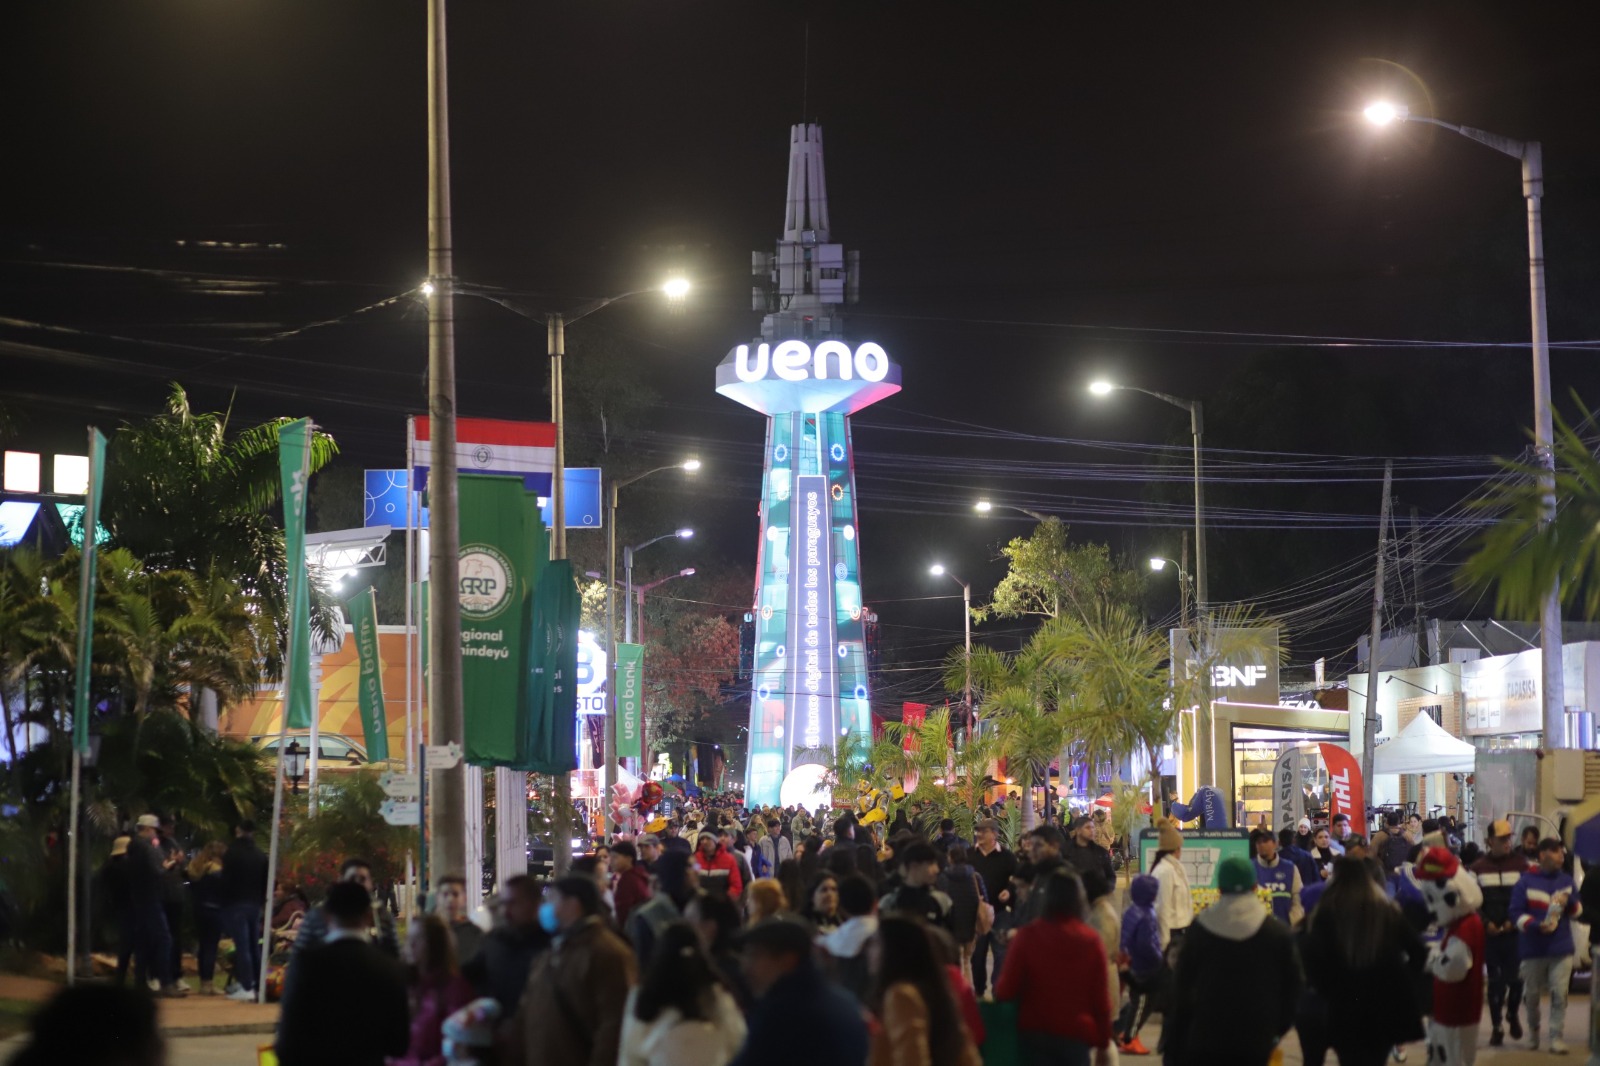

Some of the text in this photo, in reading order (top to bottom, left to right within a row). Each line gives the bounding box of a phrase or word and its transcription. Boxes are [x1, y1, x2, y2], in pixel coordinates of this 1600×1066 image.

[735, 340, 889, 382] ueno
[807, 491, 821, 566] paraguayos
[459, 577, 497, 595] ARP
[804, 568, 818, 588] los
[804, 590, 818, 628] todos
[460, 628, 503, 642] gional
[460, 644, 510, 660] nindeyú
[805, 630, 819, 646] de
[805, 648, 822, 692] digital
[1210, 665, 1266, 686] BNF
[622, 660, 637, 740] ueno bank
[805, 694, 820, 735] banco
[1282, 758, 1295, 830] APASISA
